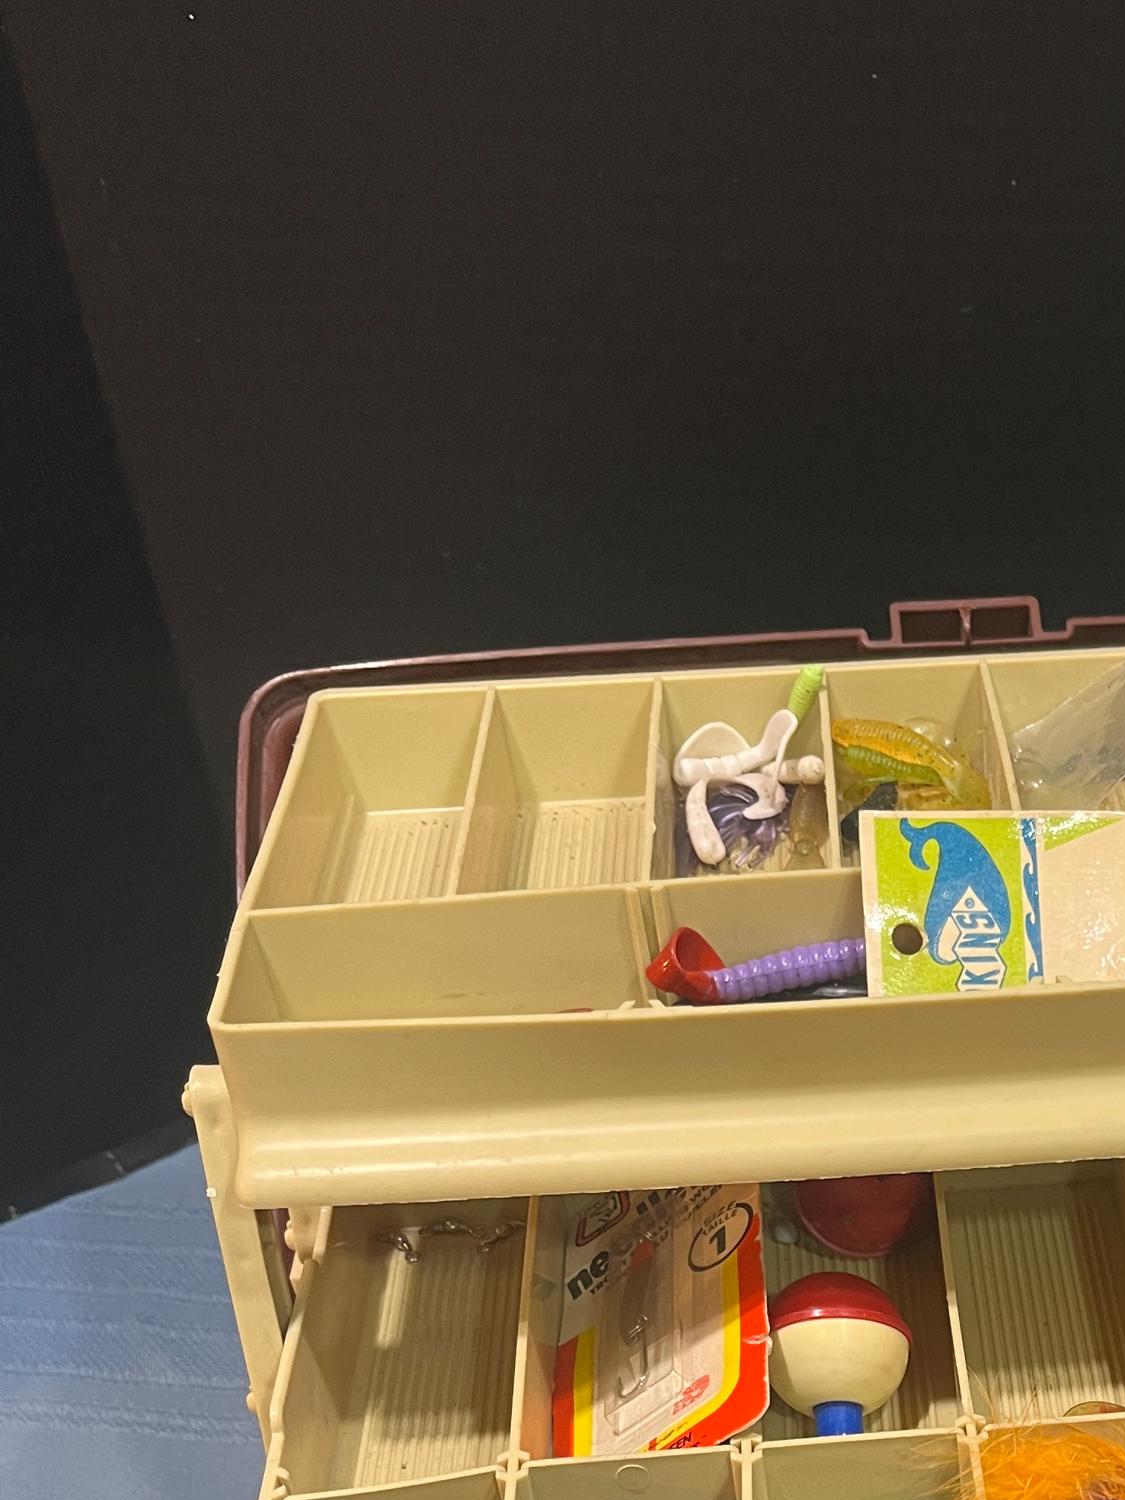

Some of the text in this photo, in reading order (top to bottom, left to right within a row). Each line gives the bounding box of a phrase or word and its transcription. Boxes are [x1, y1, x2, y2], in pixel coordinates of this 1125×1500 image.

[954, 912, 1003, 990] KINS
[703, 1200, 739, 1236] SIZE TAILLE
[708, 1226, 727, 1256] 1
